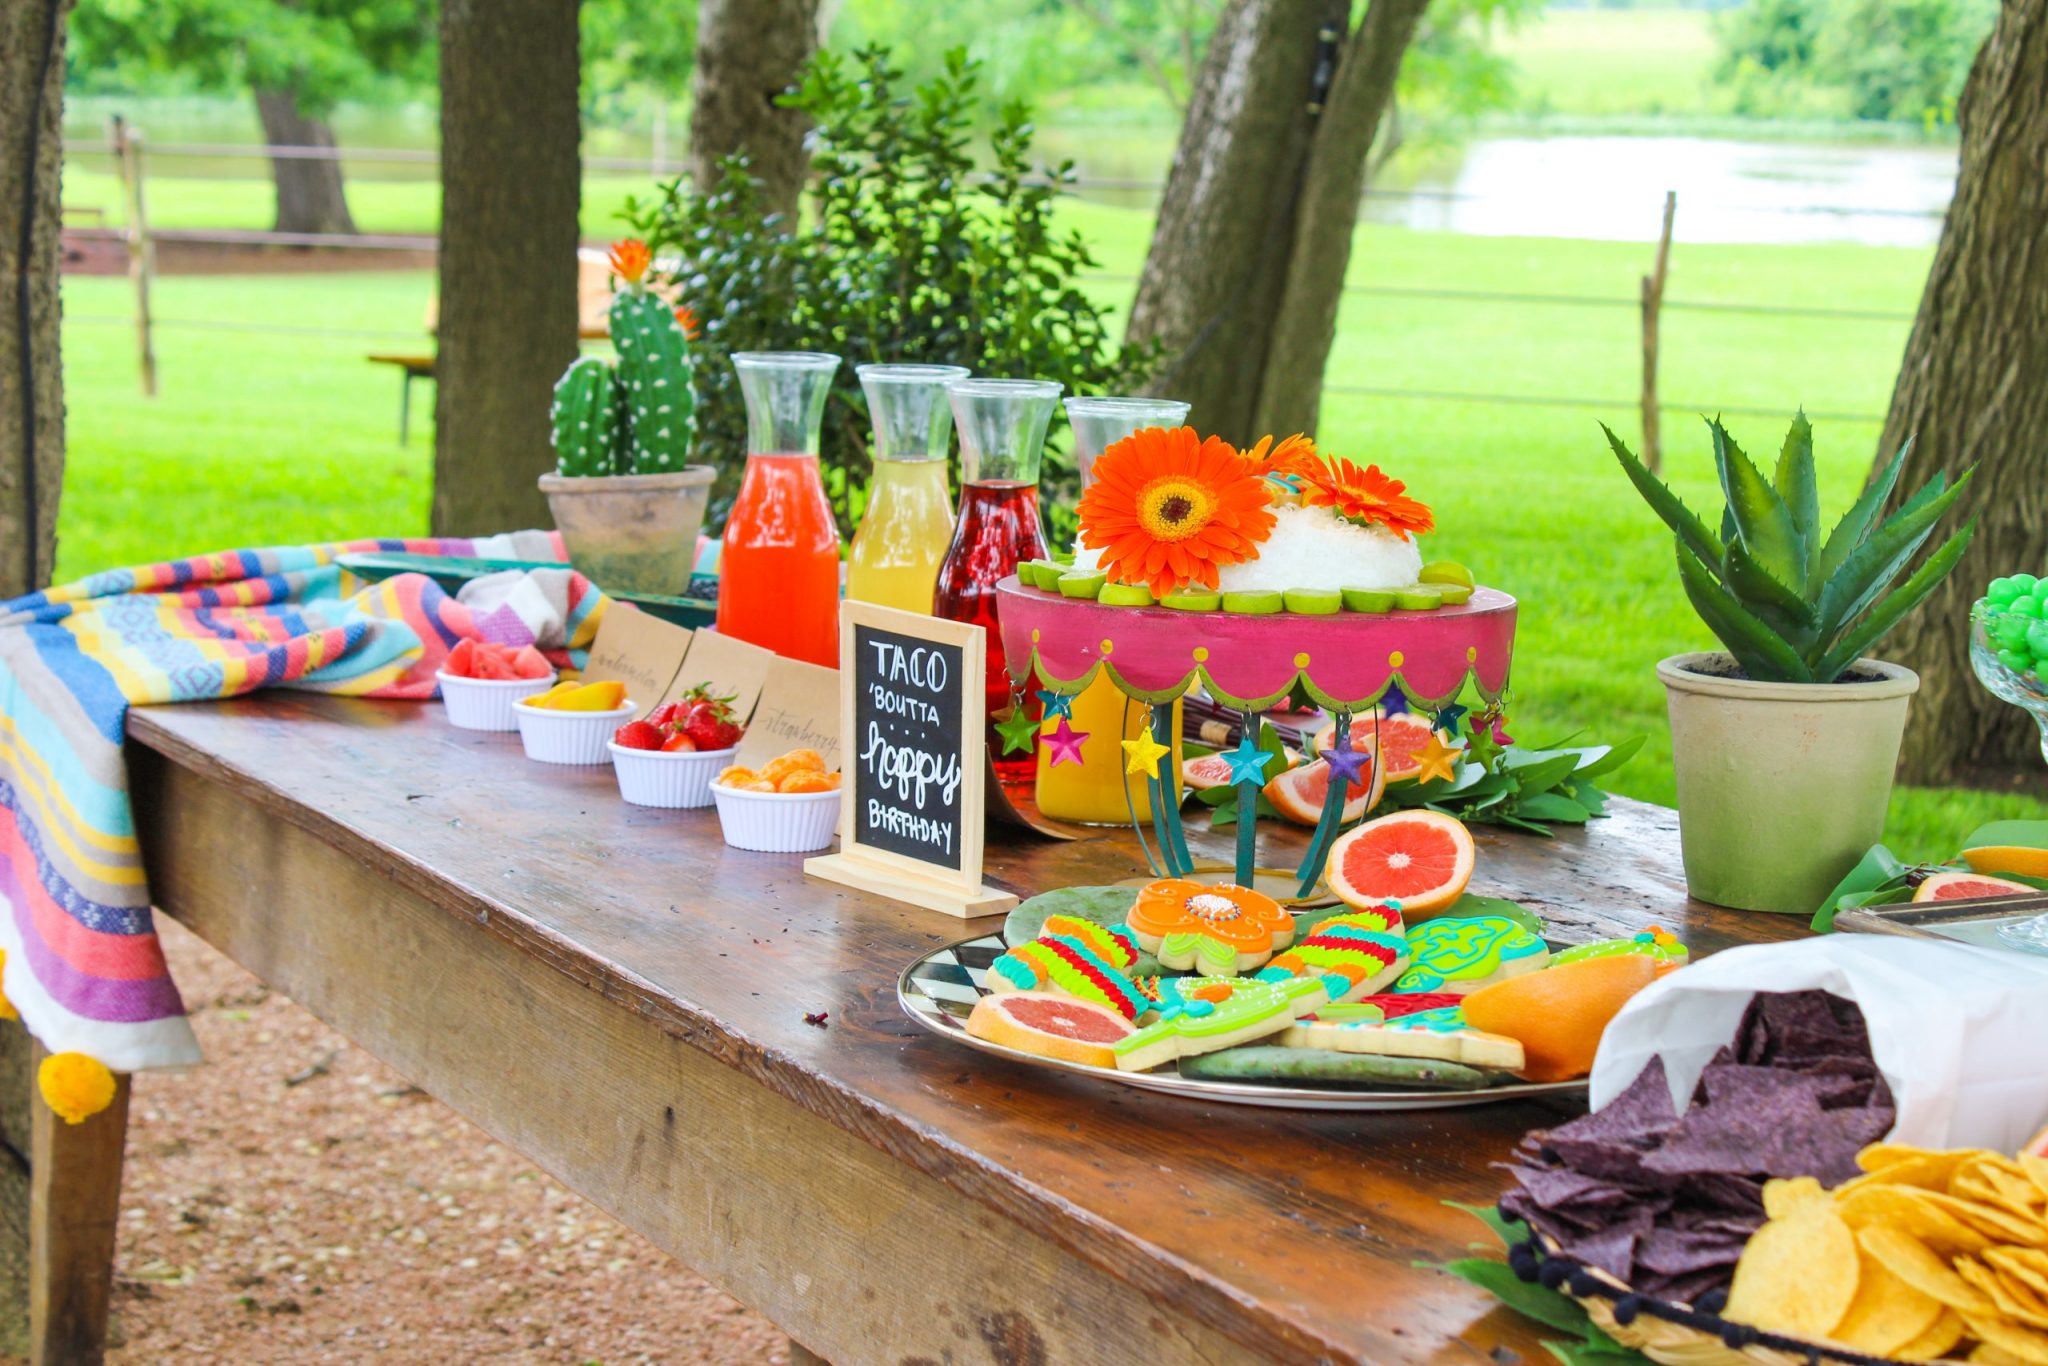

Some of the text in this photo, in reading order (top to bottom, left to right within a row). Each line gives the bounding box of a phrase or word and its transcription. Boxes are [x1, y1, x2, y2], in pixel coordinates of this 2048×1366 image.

[869, 640, 947, 692] TACO
[869, 682, 940, 727] 'BOUTTA
[758, 708, 840, 757] strawberry
[860, 721, 961, 809] happy
[868, 799, 953, 855] BIRTHDAY
